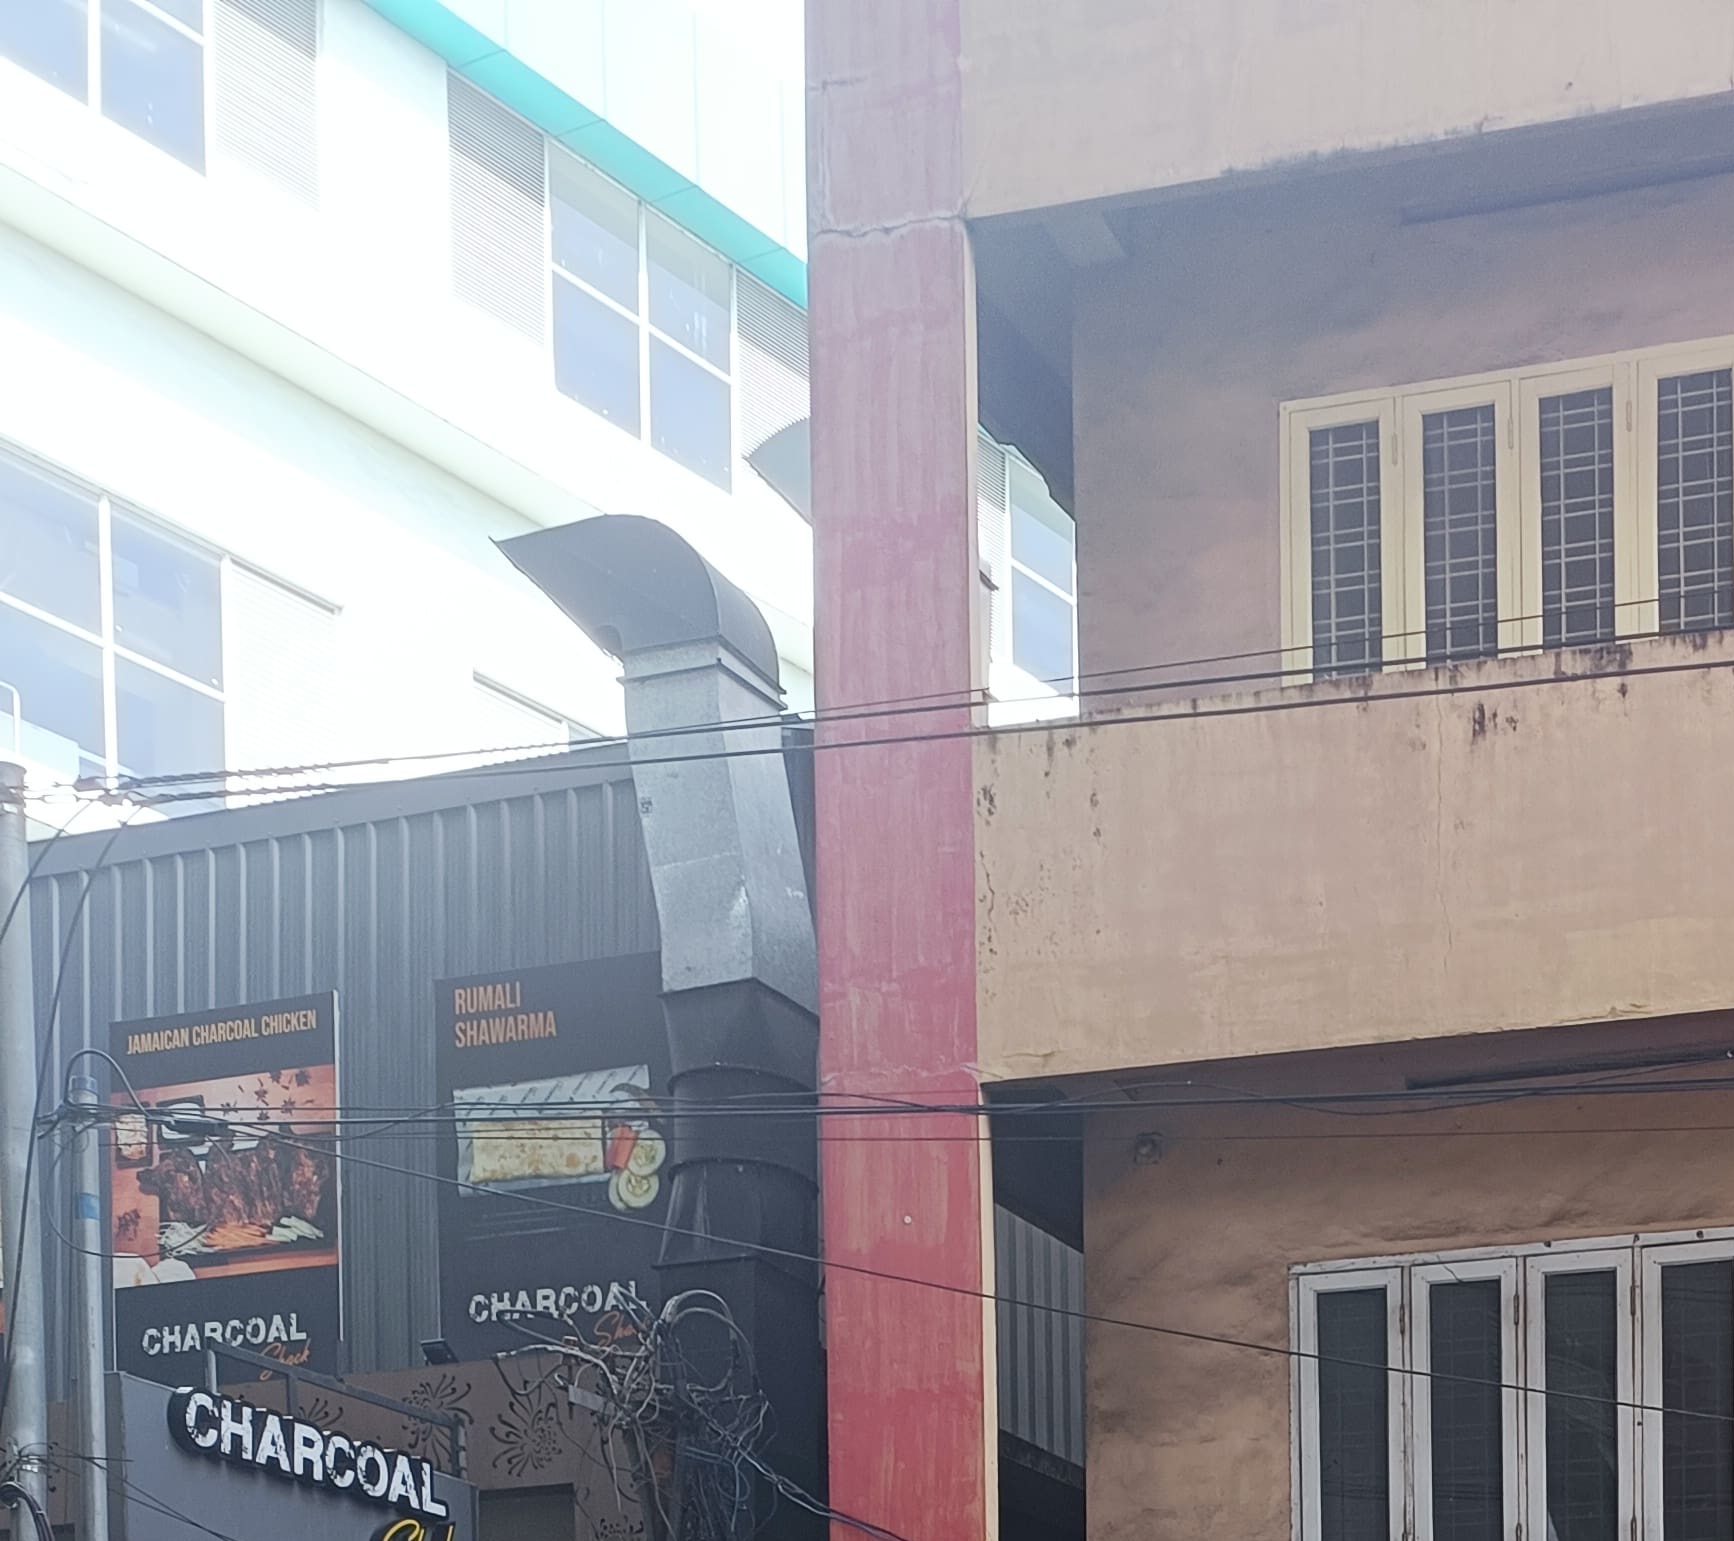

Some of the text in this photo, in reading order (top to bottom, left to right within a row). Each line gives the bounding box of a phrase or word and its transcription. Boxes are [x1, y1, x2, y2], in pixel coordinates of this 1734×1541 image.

[455, 981, 521, 1015] RUMALI
[127, 1009, 317, 1055] JAMAICAN CHARCOAL CHICKEN
[455, 1010, 557, 1048] SHAWARMA
[469, 1281, 647, 1322] CHARCOAL
[142, 1313, 307, 1355] CHARCOAL
[185, 1393, 447, 1517] CHARCOAL
